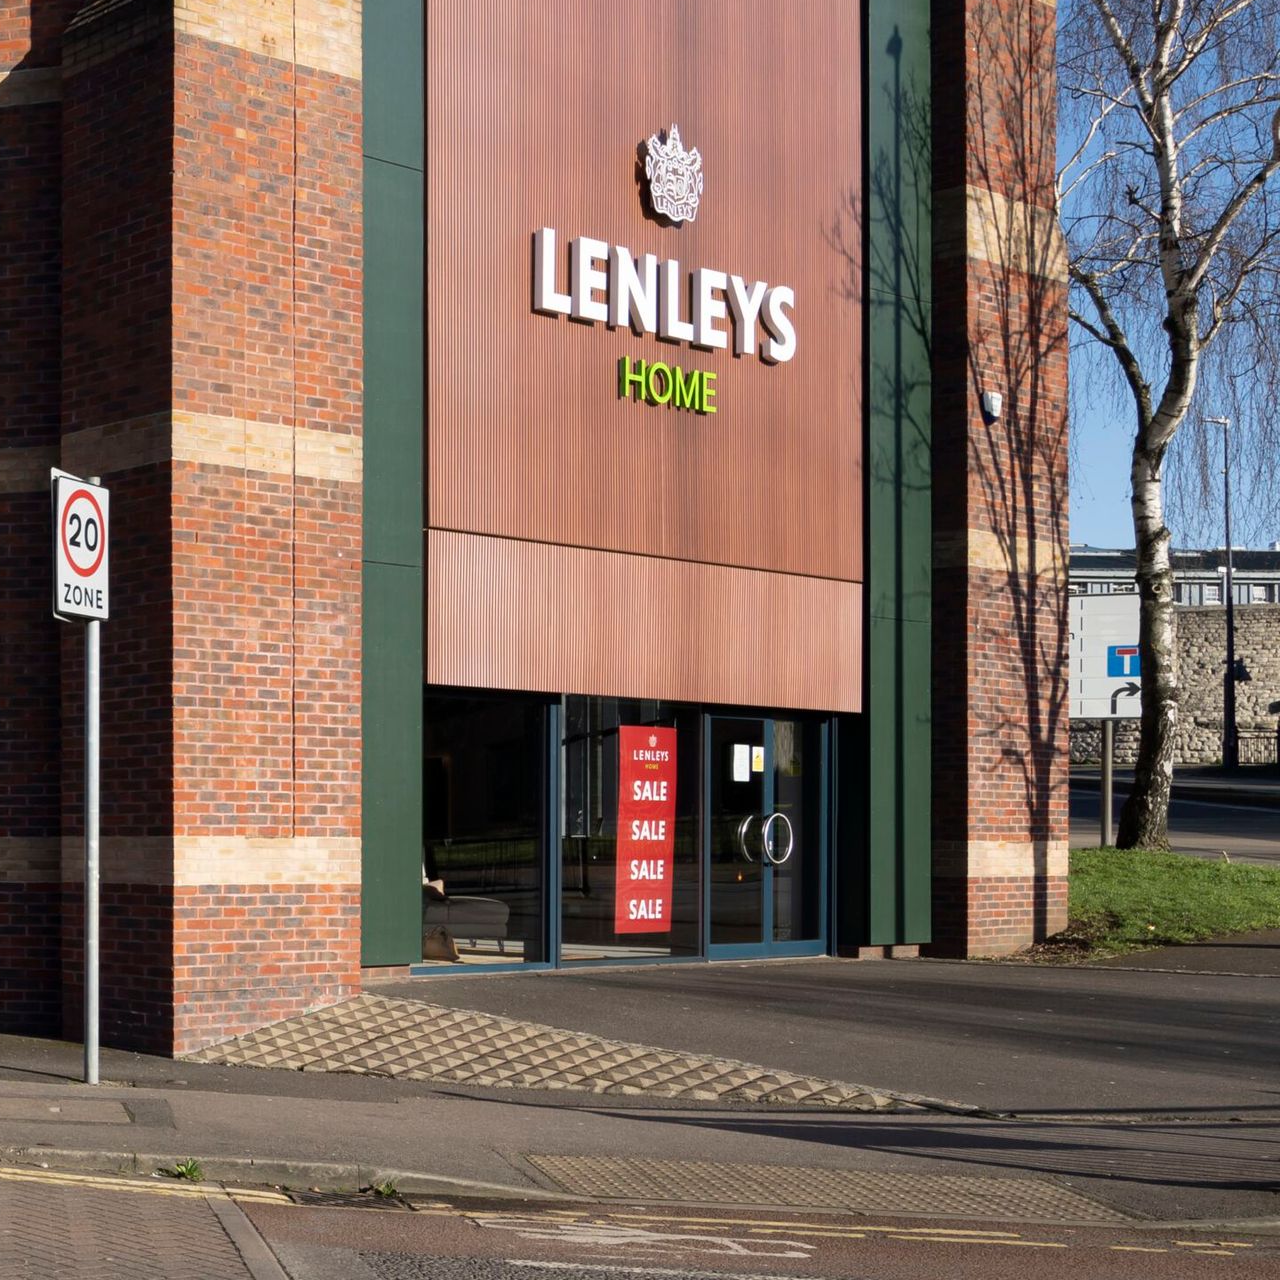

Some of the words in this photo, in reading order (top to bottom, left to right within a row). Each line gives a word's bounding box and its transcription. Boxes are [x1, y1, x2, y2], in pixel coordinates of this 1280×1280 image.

[656, 197, 693, 217] LENLEYS
[534, 226, 797, 362] LENLEYS
[620, 354, 718, 413] HOME
[69, 513, 99, 552] 20
[63, 583, 104, 609] ZONE
[633, 749, 669, 762] LENLEYS
[633, 780, 668, 801] SALE
[631, 819, 666, 841] SALE
[630, 859, 664, 880] SALE
[628, 898, 663, 920] SALE
